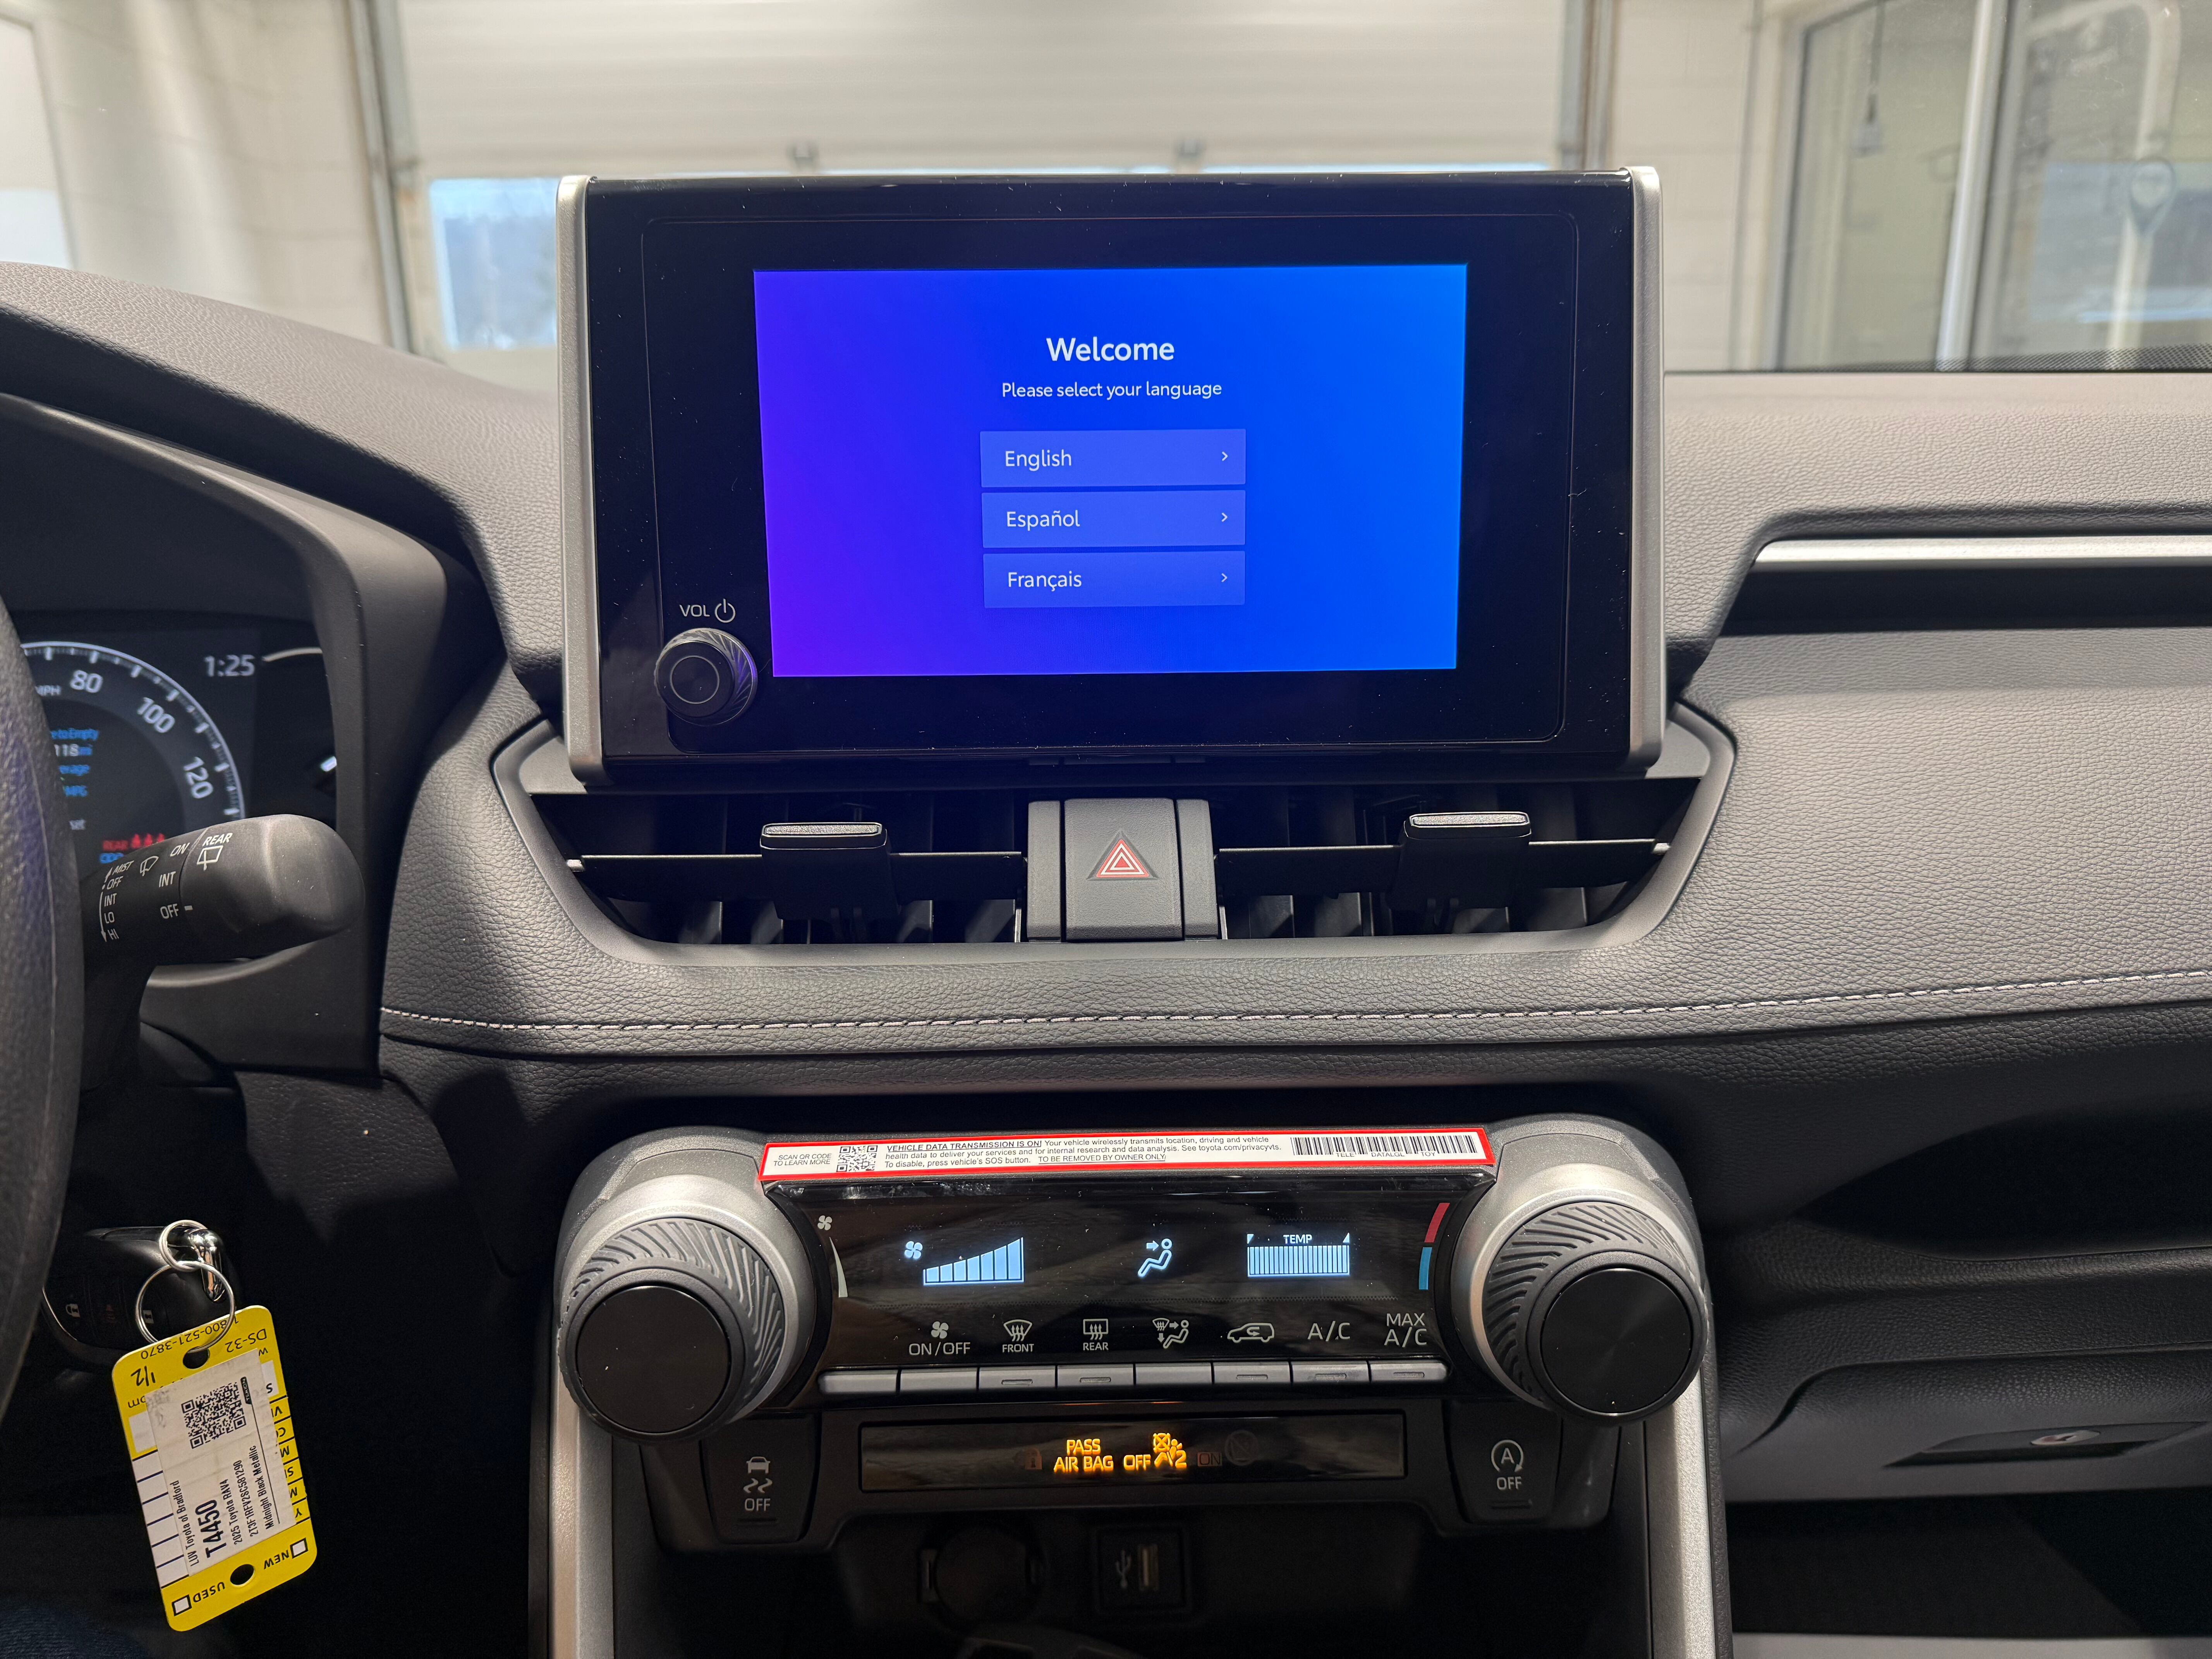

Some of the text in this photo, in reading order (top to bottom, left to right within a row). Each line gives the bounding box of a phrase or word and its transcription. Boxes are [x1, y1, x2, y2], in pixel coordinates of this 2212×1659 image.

[1046, 336, 1175, 362] Welcome
[1002, 381, 1222, 400] Please select your language
[1005, 450, 1072, 471] English
[1007, 510, 1080, 531] Español
[1008, 571, 1082, 591] Français
[679, 605, 710, 617] VOL
[204, 654, 256, 677] 1:25
[70, 670, 103, 693] 80
[137, 697, 175, 733] 100
[183, 757, 213, 799] 120
[203, 833, 233, 847] REAR
[170, 843, 190, 857] ON
[112, 860, 134, 875] MIST
[106, 876, 124, 890] OFF
[159, 871, 176, 888] INT
[104, 893, 117, 907] INT
[104, 911, 115, 924] LO
[160, 903, 179, 919] OFF
[107, 929, 119, 940] HI
[950, 1141, 1015, 1149] TRANSMISSION
[1283, 1234, 1312, 1244] TEMP
[1386, 1313, 1425, 1326] MAX
[141, 1315, 239, 1359] 1800-521-3870
[1307, 1321, 1350, 1341] A/C
[1384, 1326, 1427, 1347] A/C
[225, 1328, 267, 1353] DS-32
[1002, 1344, 1034, 1353] FRONT
[1083, 1342, 1109, 1351] REAR
[1067, 1438, 1101, 1455] PASS
[1054, 1456, 1079, 1472] AIR
[1084, 1455, 1114, 1471] BAG
[1123, 1454, 1151, 1470] OFF
[249, 1446, 274, 1529] Midnight Black Metallic
[1496, 1476, 1522, 1490] OFF
[170, 1480, 186, 1514] Bradford
[744, 1498, 771, 1511] OFF
[220, 1479, 242, 1545] 2025 Toyota RAV4
[183, 1523, 195, 1550] Toyota
[195, 1499, 227, 1558] T4450
[187, 1550, 199, 1566] LUV
[264, 1549, 289, 1570] NEW
[193, 1582, 225, 1603] USED
